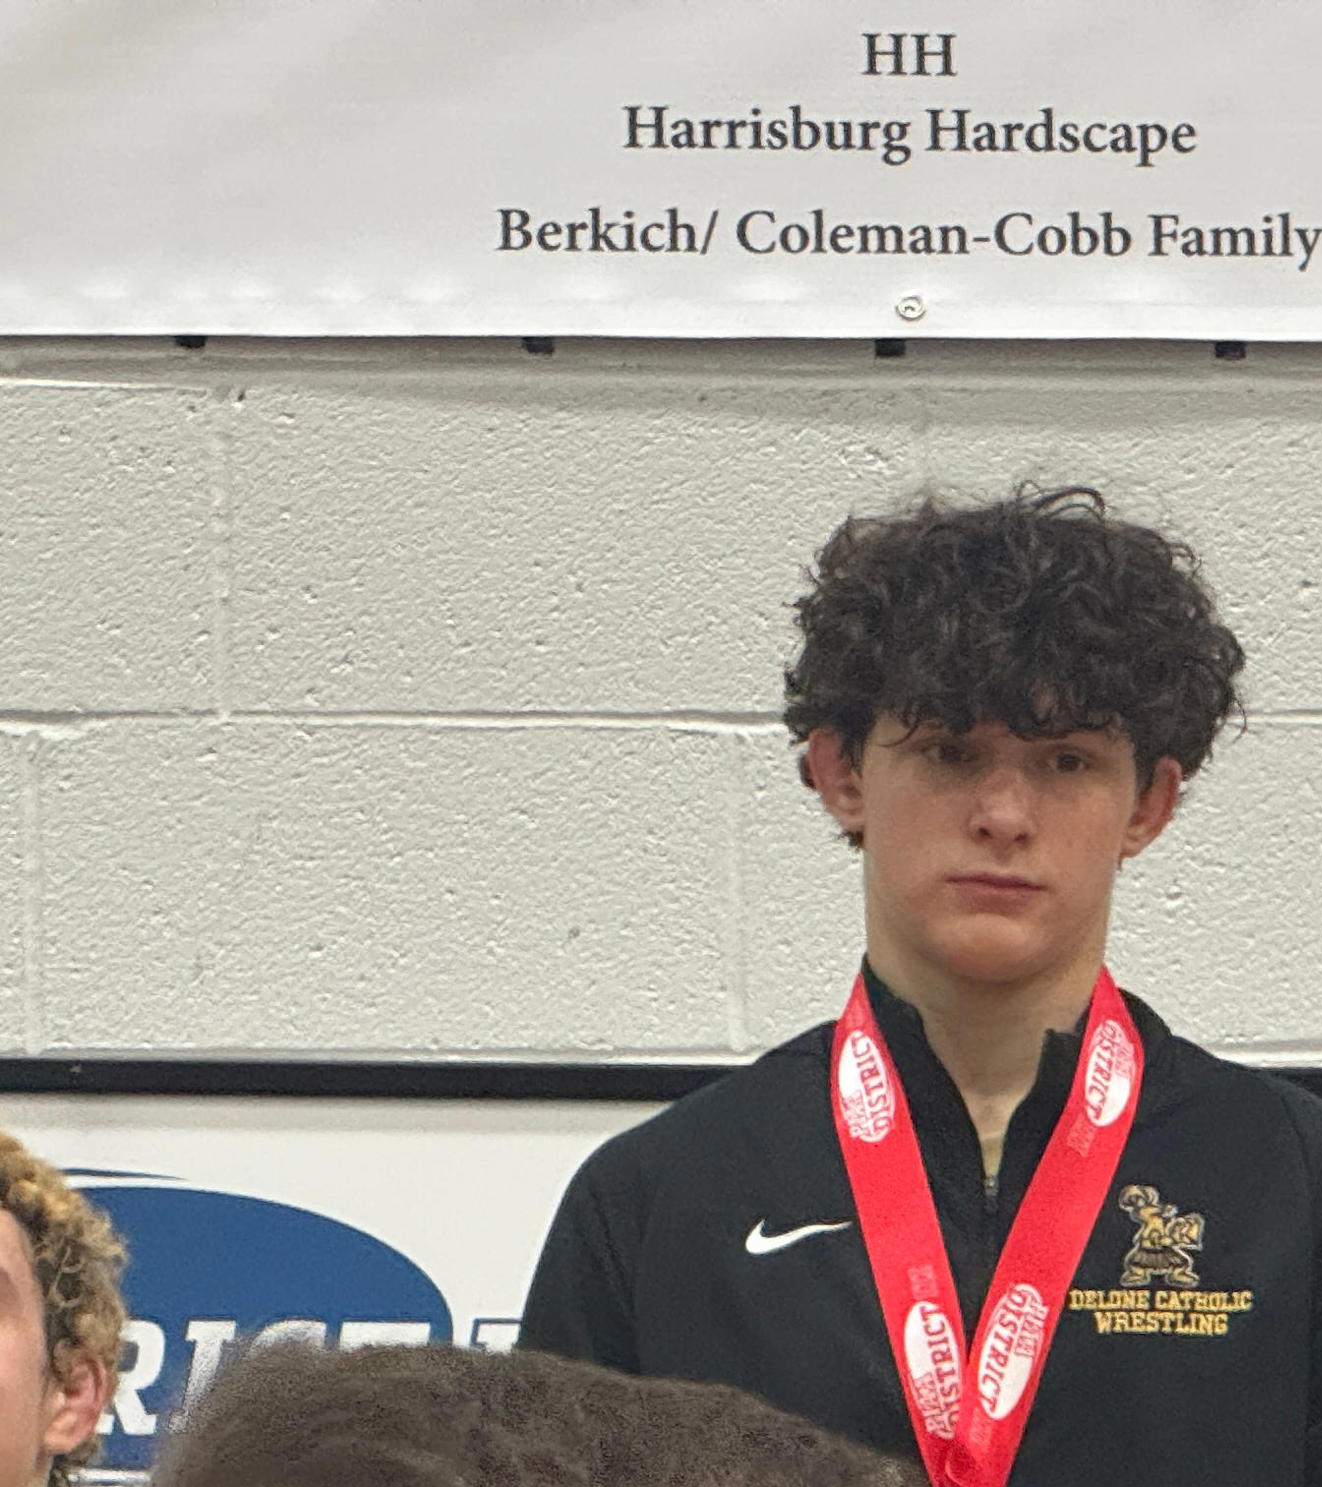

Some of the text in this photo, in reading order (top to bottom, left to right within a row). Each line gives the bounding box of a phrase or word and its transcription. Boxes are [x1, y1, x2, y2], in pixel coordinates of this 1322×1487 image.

[861, 32, 957, 77] HH
[623, 105, 1198, 166] Harrisburg Hardscape
[497, 208, 720, 256] Berkich/
[735, 208, 1132, 258] Coleman-Cobb
[1068, 1289, 1253, 1313] DELONE CATHOLIC
[1094, 1311, 1230, 1336] WRESTLING
[980, 1285, 1028, 1413] DISTRICT
